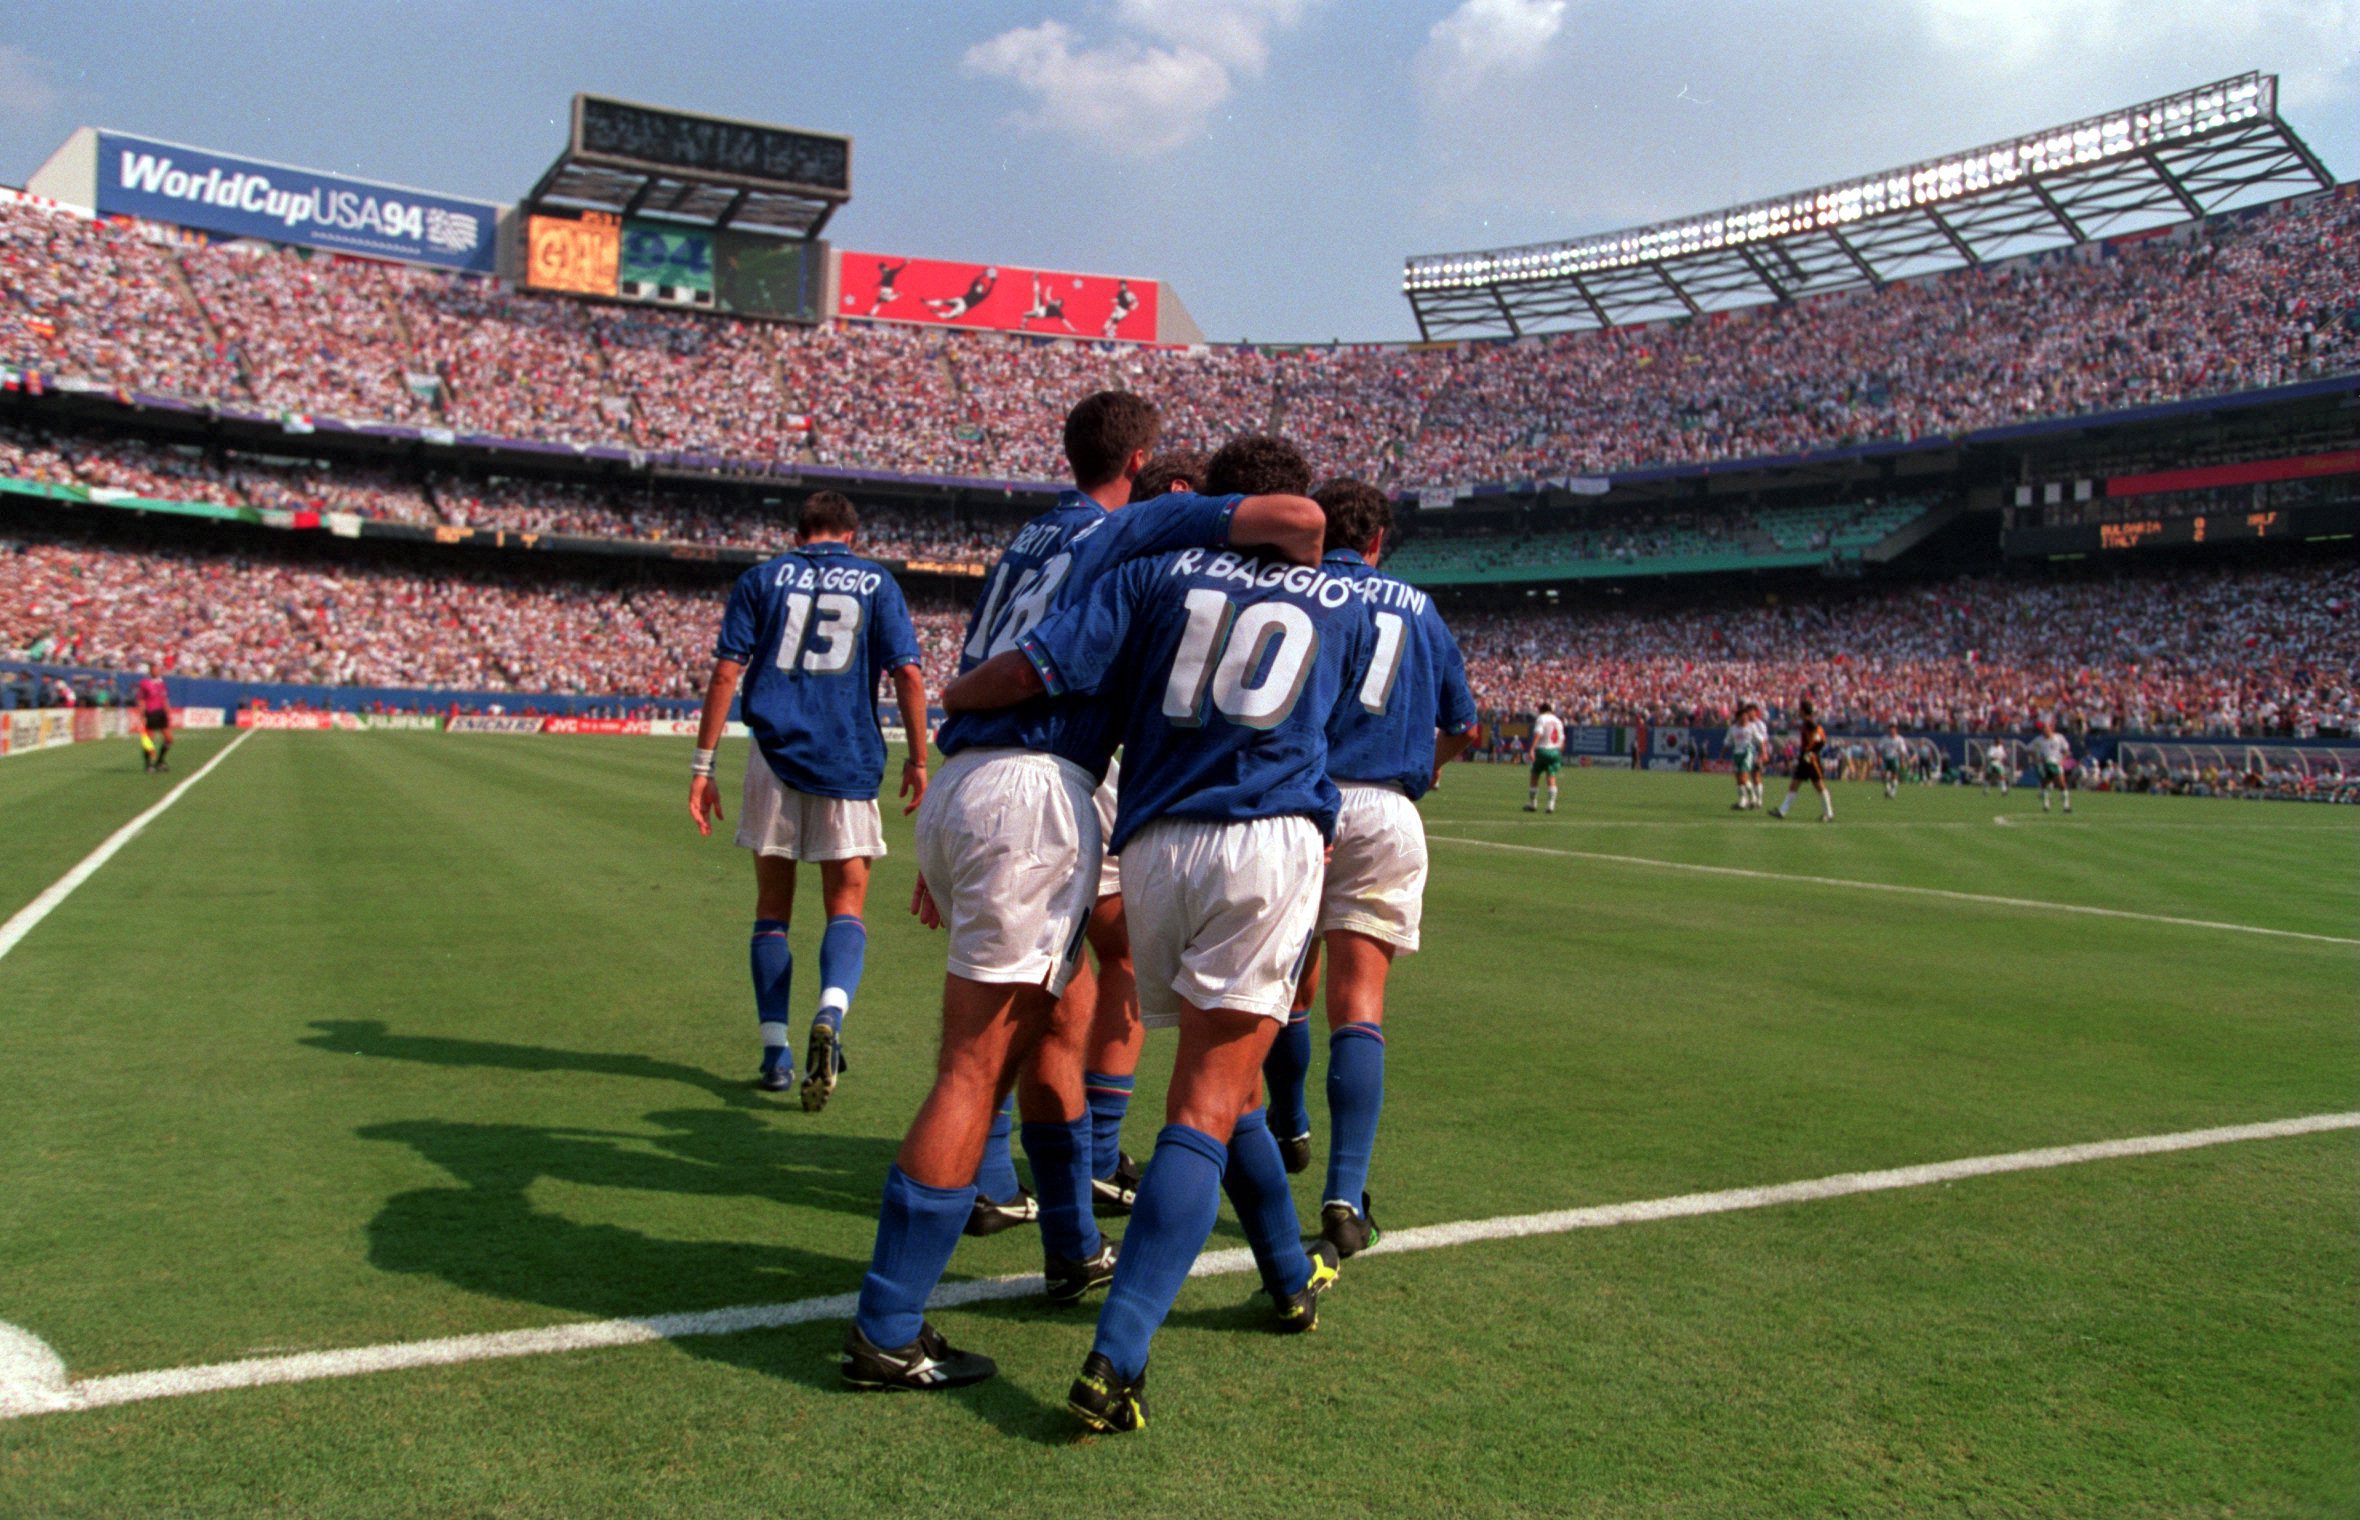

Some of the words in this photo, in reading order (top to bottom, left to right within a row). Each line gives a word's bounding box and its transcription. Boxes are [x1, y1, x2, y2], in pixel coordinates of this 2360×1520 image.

[774, 562, 796, 587] D.
[1170, 547, 1205, 577] R.
[1205, 551, 1350, 609] BAGGIO
[775, 592, 864, 675] 13
[1162, 588, 1320, 730] 10
[549, 718, 578, 732] JVC
[621, 720, 650, 734] JVC
